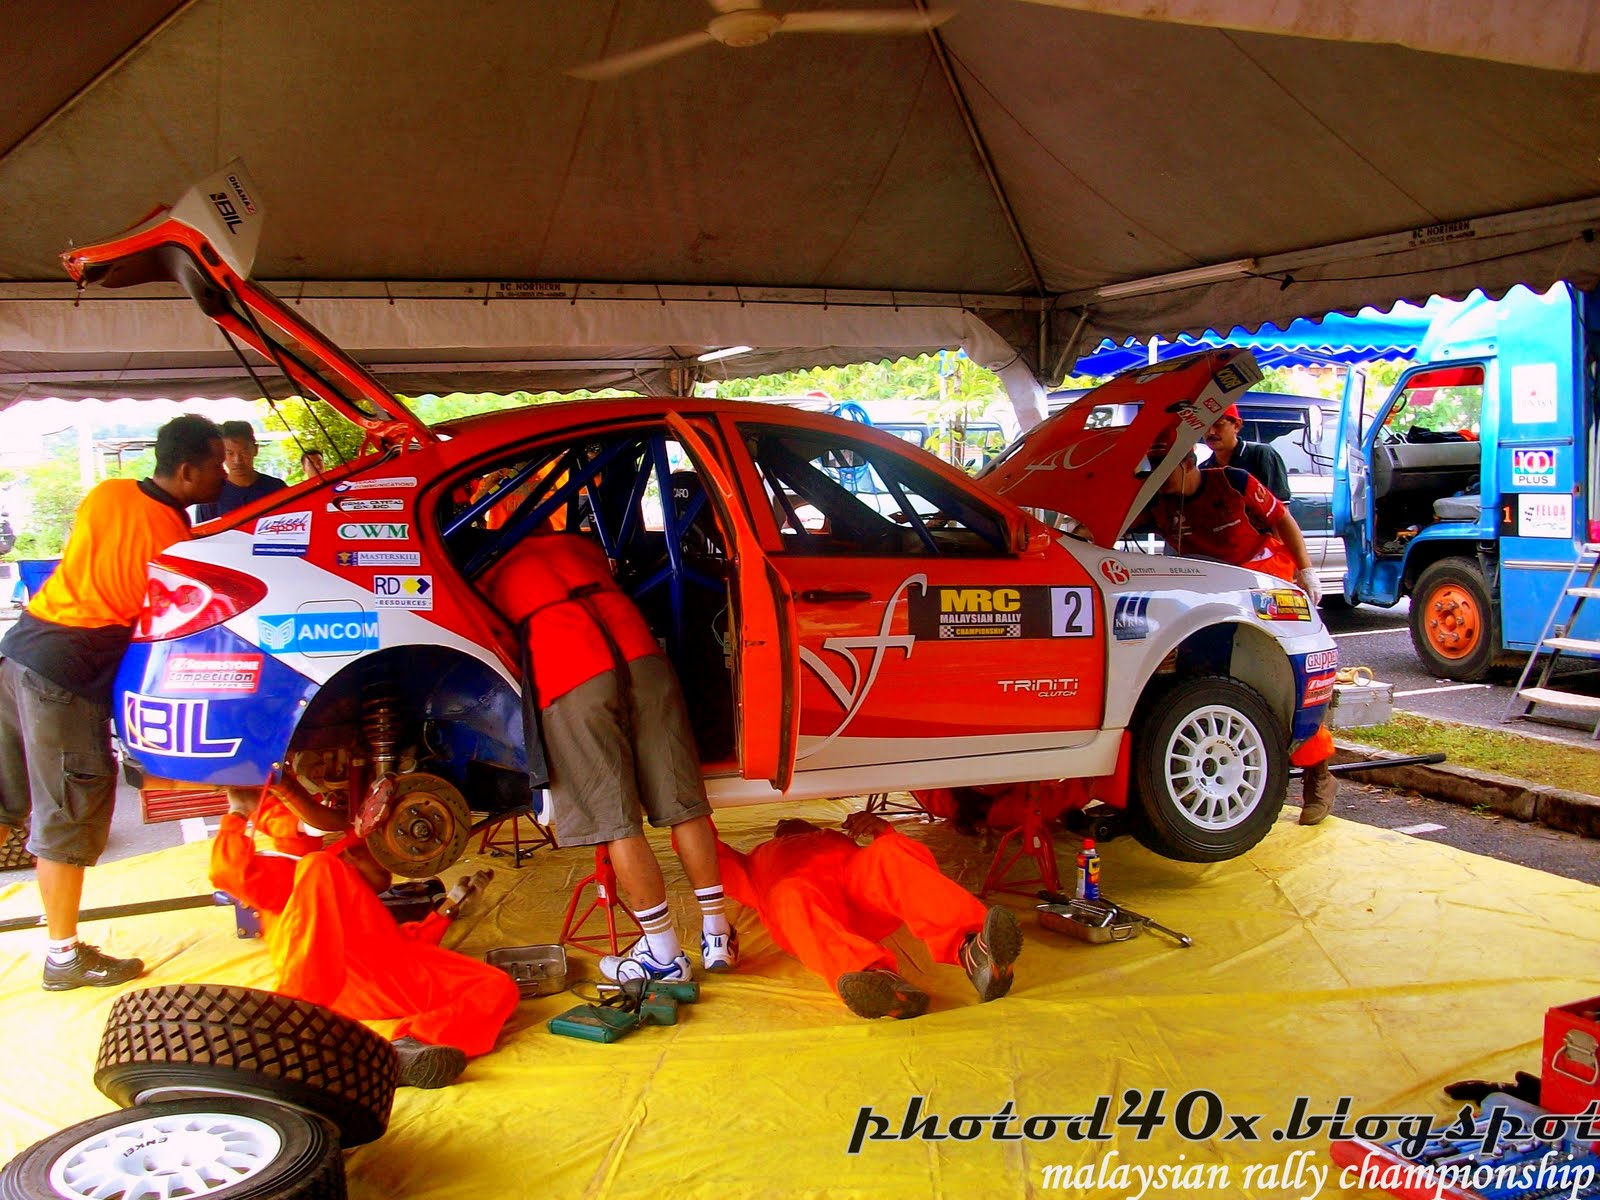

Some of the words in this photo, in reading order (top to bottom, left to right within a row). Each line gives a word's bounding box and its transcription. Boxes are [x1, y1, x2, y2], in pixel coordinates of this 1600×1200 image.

[1518, 475, 1549, 484] PLUS
[270, 523, 306, 535] sport
[340, 524, 409, 539] CWM
[375, 577, 401, 595] RD
[940, 588, 1021, 612] MRC
[940, 614, 993, 624] MALAYSIAN
[995, 613, 1022, 623] RALLY
[1064, 591, 1083, 633] 2
[297, 623, 379, 641] ANCOM
[956, 627, 1005, 635] CHAMPIONSHIP
[1307, 651, 1337, 669] GRIPPE
